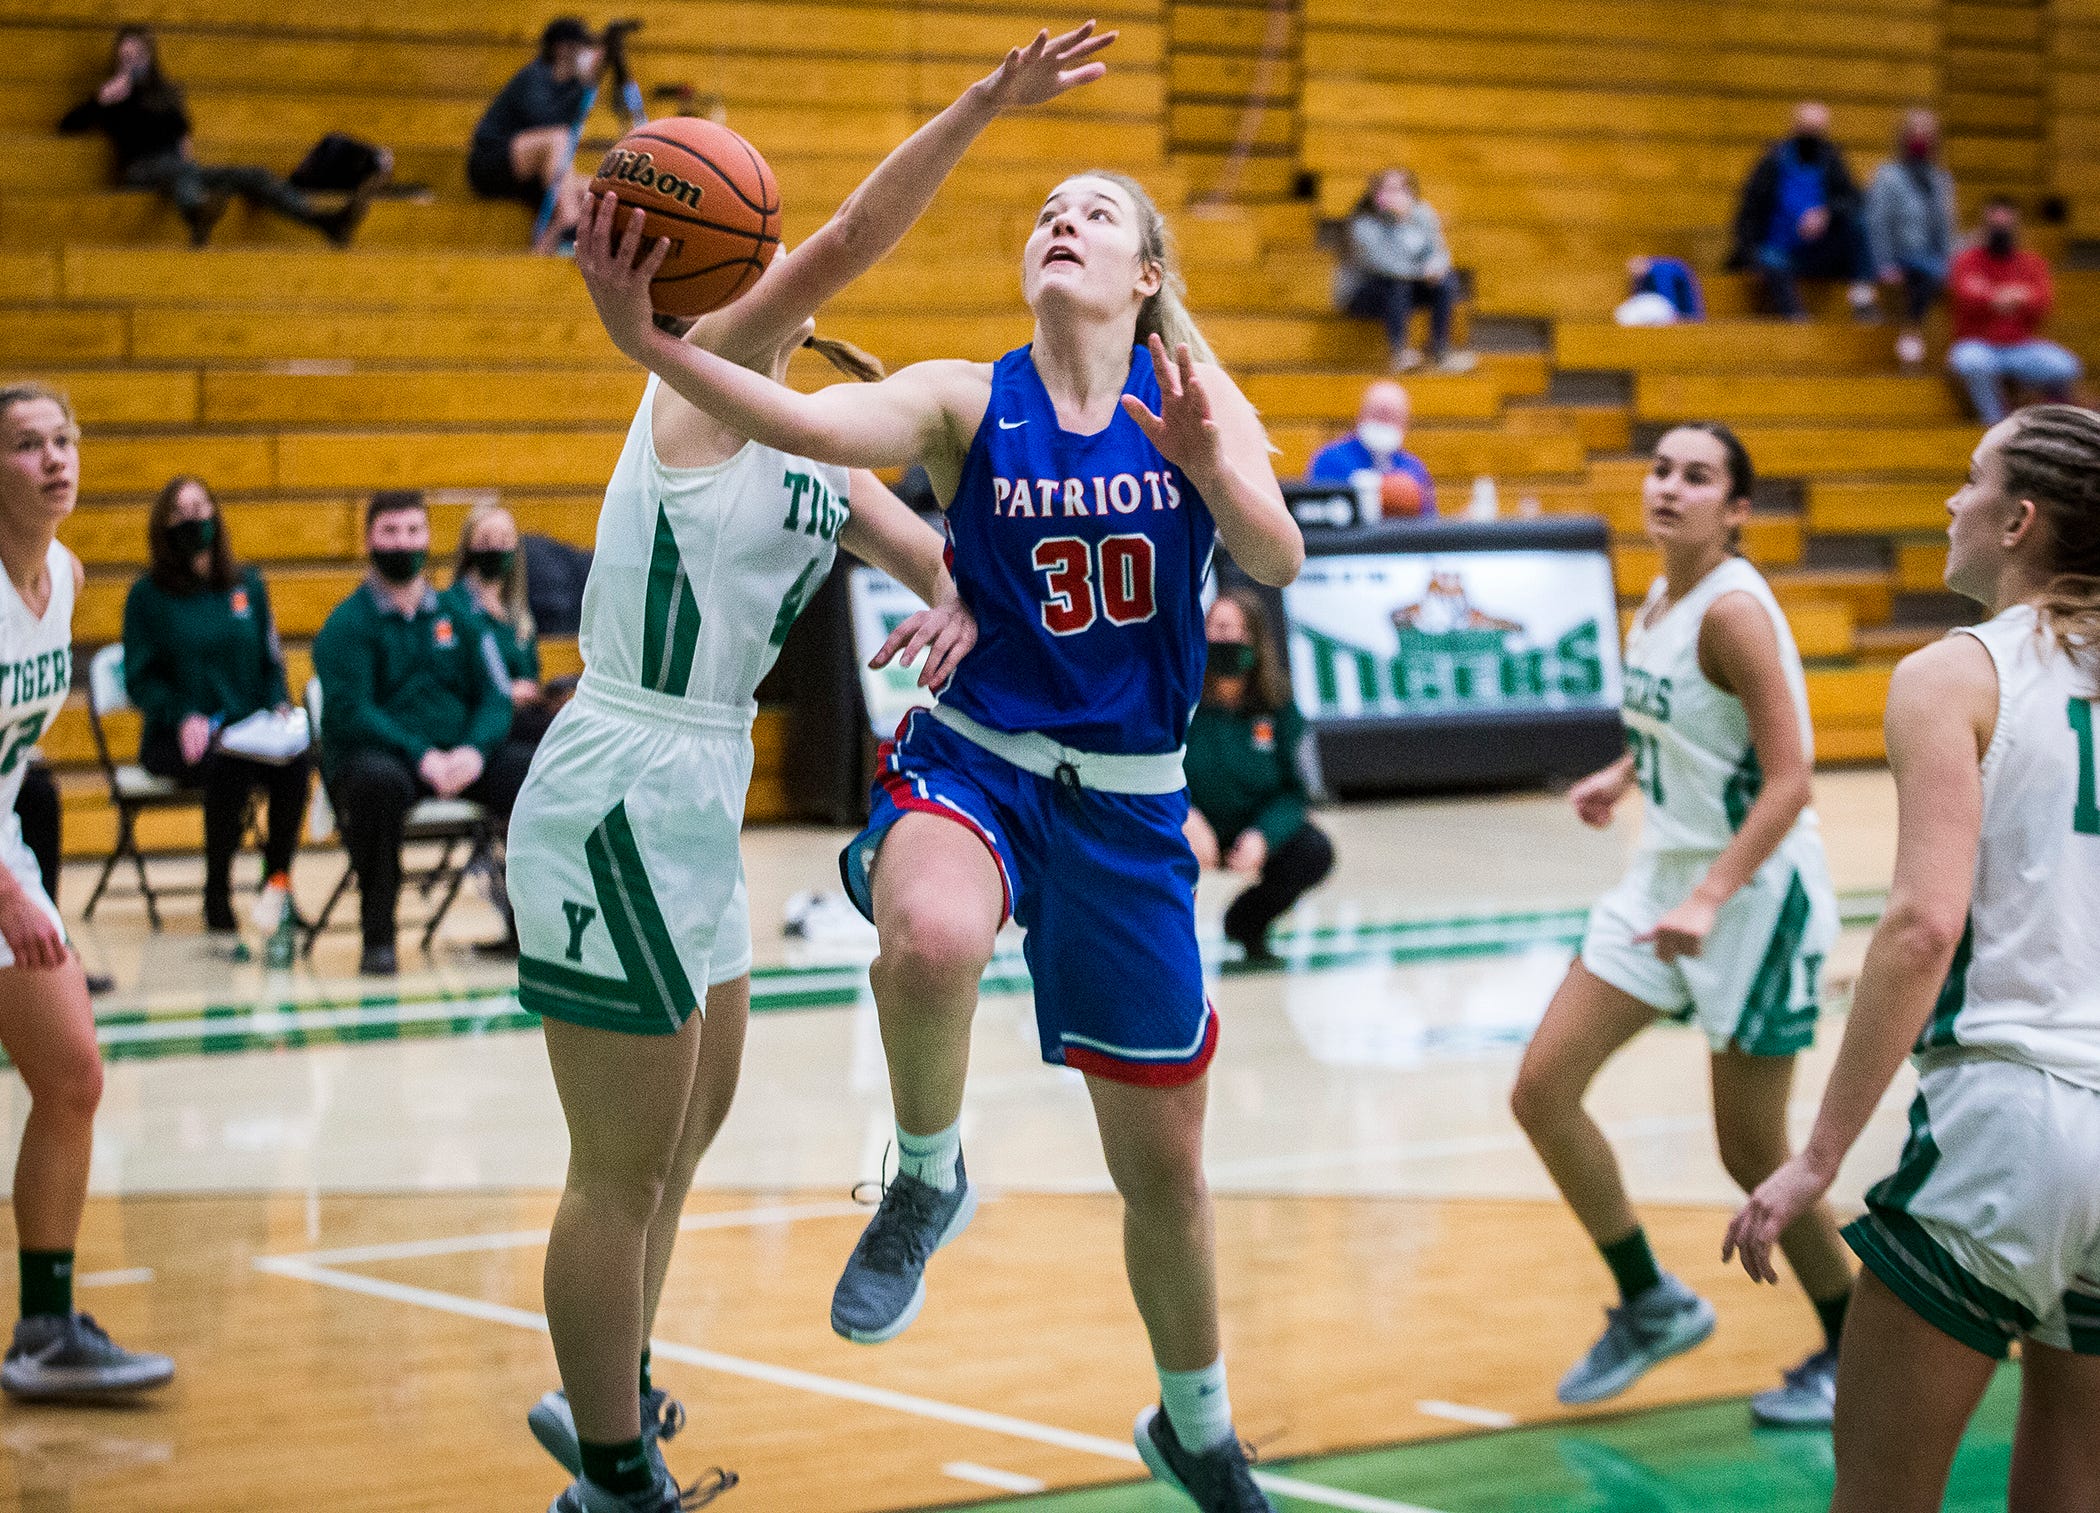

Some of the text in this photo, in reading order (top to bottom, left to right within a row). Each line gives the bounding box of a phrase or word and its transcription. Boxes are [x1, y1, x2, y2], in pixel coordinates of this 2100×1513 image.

[992, 470, 1181, 518] PATRIOTS
[1032, 532, 1157, 637] 30
[561, 898, 597, 964] Y
